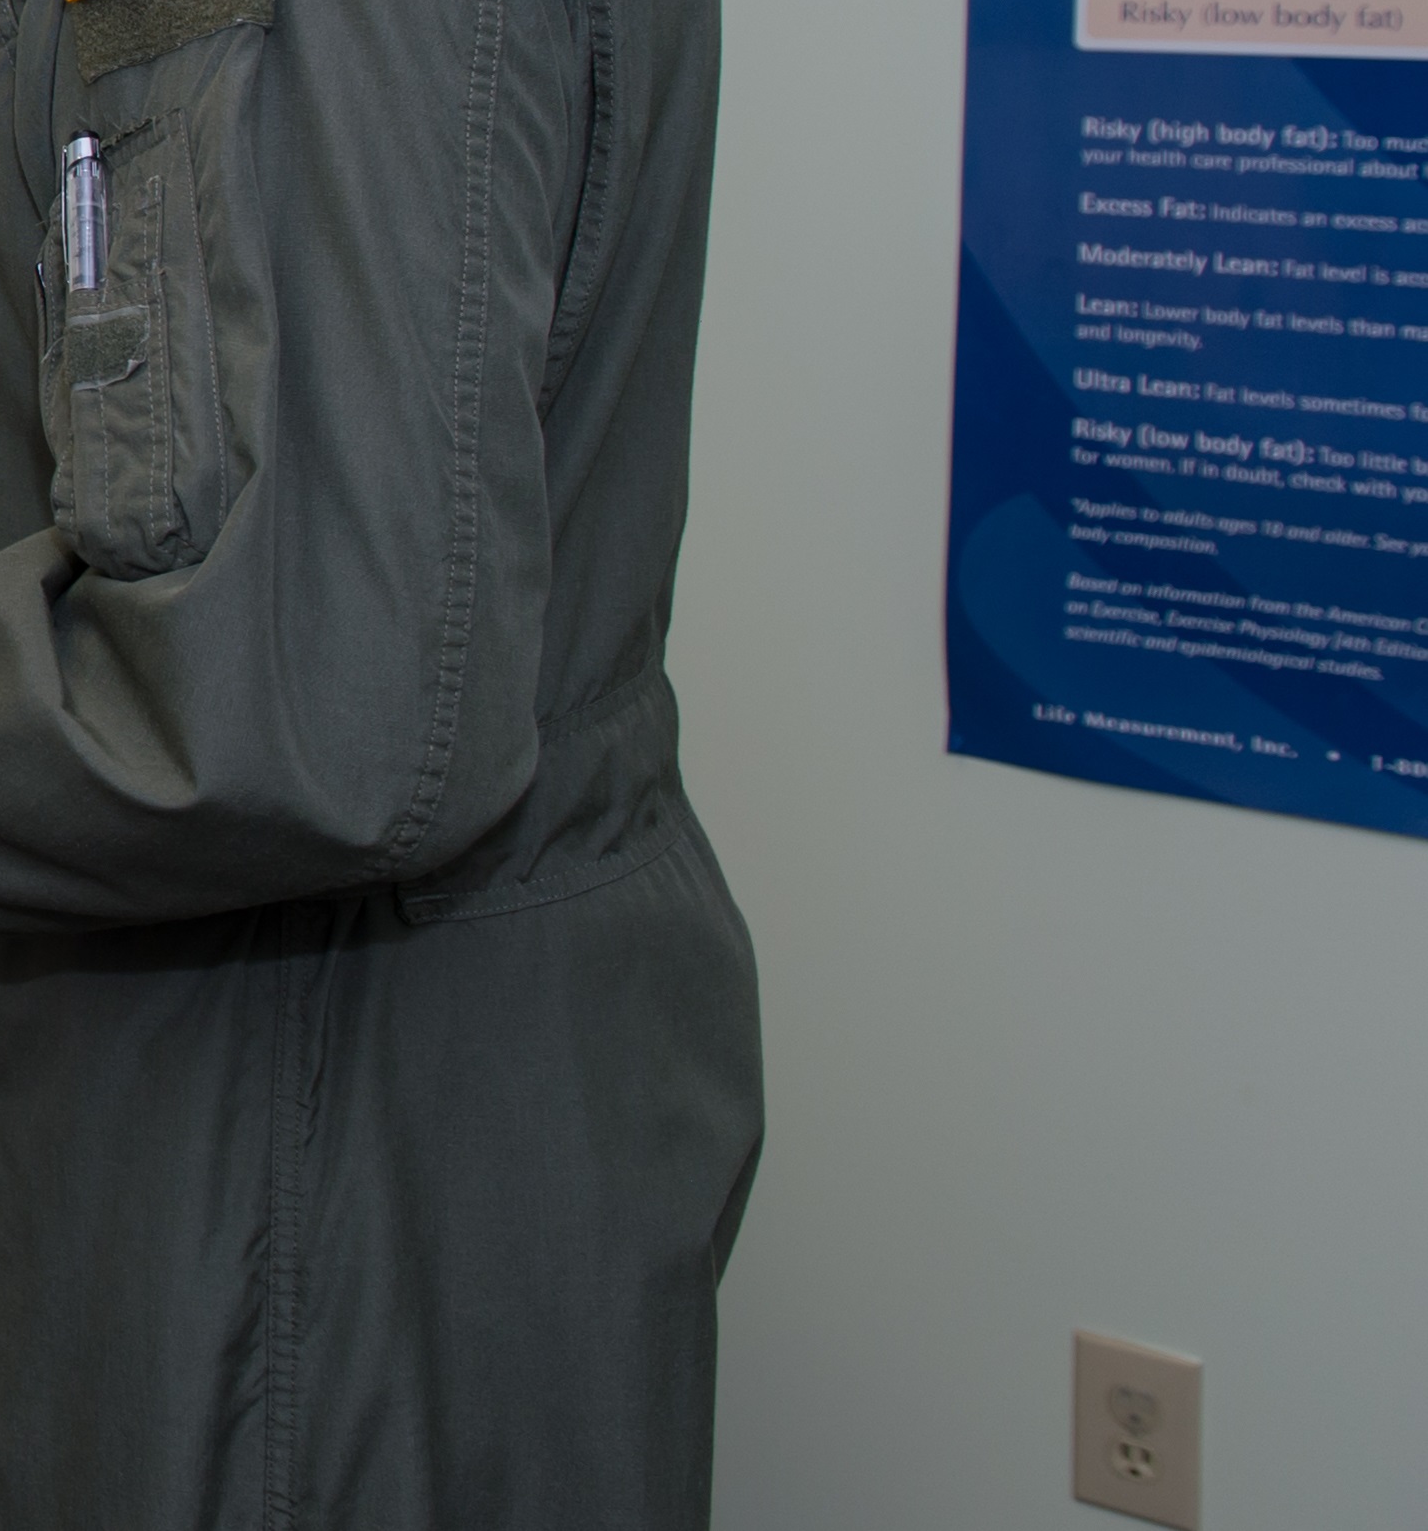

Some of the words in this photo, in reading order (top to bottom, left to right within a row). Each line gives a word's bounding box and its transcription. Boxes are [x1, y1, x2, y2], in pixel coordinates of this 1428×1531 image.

[1121, 0, 1192, 31] Risky
[1203, 0, 1264, 26] (low
[1273, 2, 1345, 35] body
[1357, 4, 1404, 31] fat)
[1083, 116, 1142, 144] Risky
[1149, 118, 1210, 147] (high
[1217, 122, 1275, 150] body
[1283, 124, 1338, 152] fat):
[1344, 130, 1379, 151] Too
[1384, 135, 1428, 153] muc
[1082, 148, 1123, 166] your
[1129, 149, 1187, 167] health
[1192, 153, 1233, 169] care
[1236, 154, 1354, 176] professional
[1360, 159, 1420, 180] about
[1080, 191, 1153, 217] Excess
[1160, 195, 1207, 221] Fat:
[1212, 202, 1297, 227] Indicates
[1302, 211, 1328, 228] an
[1333, 213, 1398, 233] excess
[1079, 241, 1208, 277] Moderately
[1215, 250, 1279, 277] Lean:
[1283, 258, 1315, 280] Fat
[1320, 260, 1367, 283] level
[1369, 264, 1390, 286] is
[1077, 292, 1139, 318] Lean:
[1144, 300, 1199, 322] Lower
[1203, 305, 1251, 330] body
[1255, 308, 1284, 330] fat
[1288, 311, 1344, 335] levels
[1349, 317, 1396, 339] than
[1077, 323, 1111, 341] and
[1116, 324, 1203, 351] longevity.
[1075, 367, 1131, 393] Ultra
[1139, 373, 1201, 400] Lean:
[1205, 382, 1236, 403] Fat
[1242, 385, 1295, 409] levels
[1300, 395, 1407, 420] sometimes
[1074, 416, 1132, 448] Risky
[1138, 422, 1189, 450] (low
[1196, 429, 1254, 461] body
[1320, 444, 1355, 468] Too
[1359, 449, 1408, 473] little
[1072, 445, 1100, 465] for
[1198, 459, 1219, 478] in
[1289, 471, 1347, 493] check
[1352, 478, 1397, 499] with
[1070, 523, 1111, 545] body
[1140, 506, 1160, 523] to
[1163, 509, 1215, 530] adults
[1287, 524, 1322, 542] and
[1064, 600, 1089, 615] on
[1067, 571, 1118, 594] Based
[1119, 582, 1143, 596] on
[1148, 583, 1246, 609] information
[1066, 625, 1142, 648] scientific
[1145, 636, 1178, 652] and
[1033, 702, 1076, 726] Life
[1082, 710, 1243, 753] Measurement,
[1250, 735, 1298, 759] Inc.
[1371, 754, 1428, 778] 1-80
